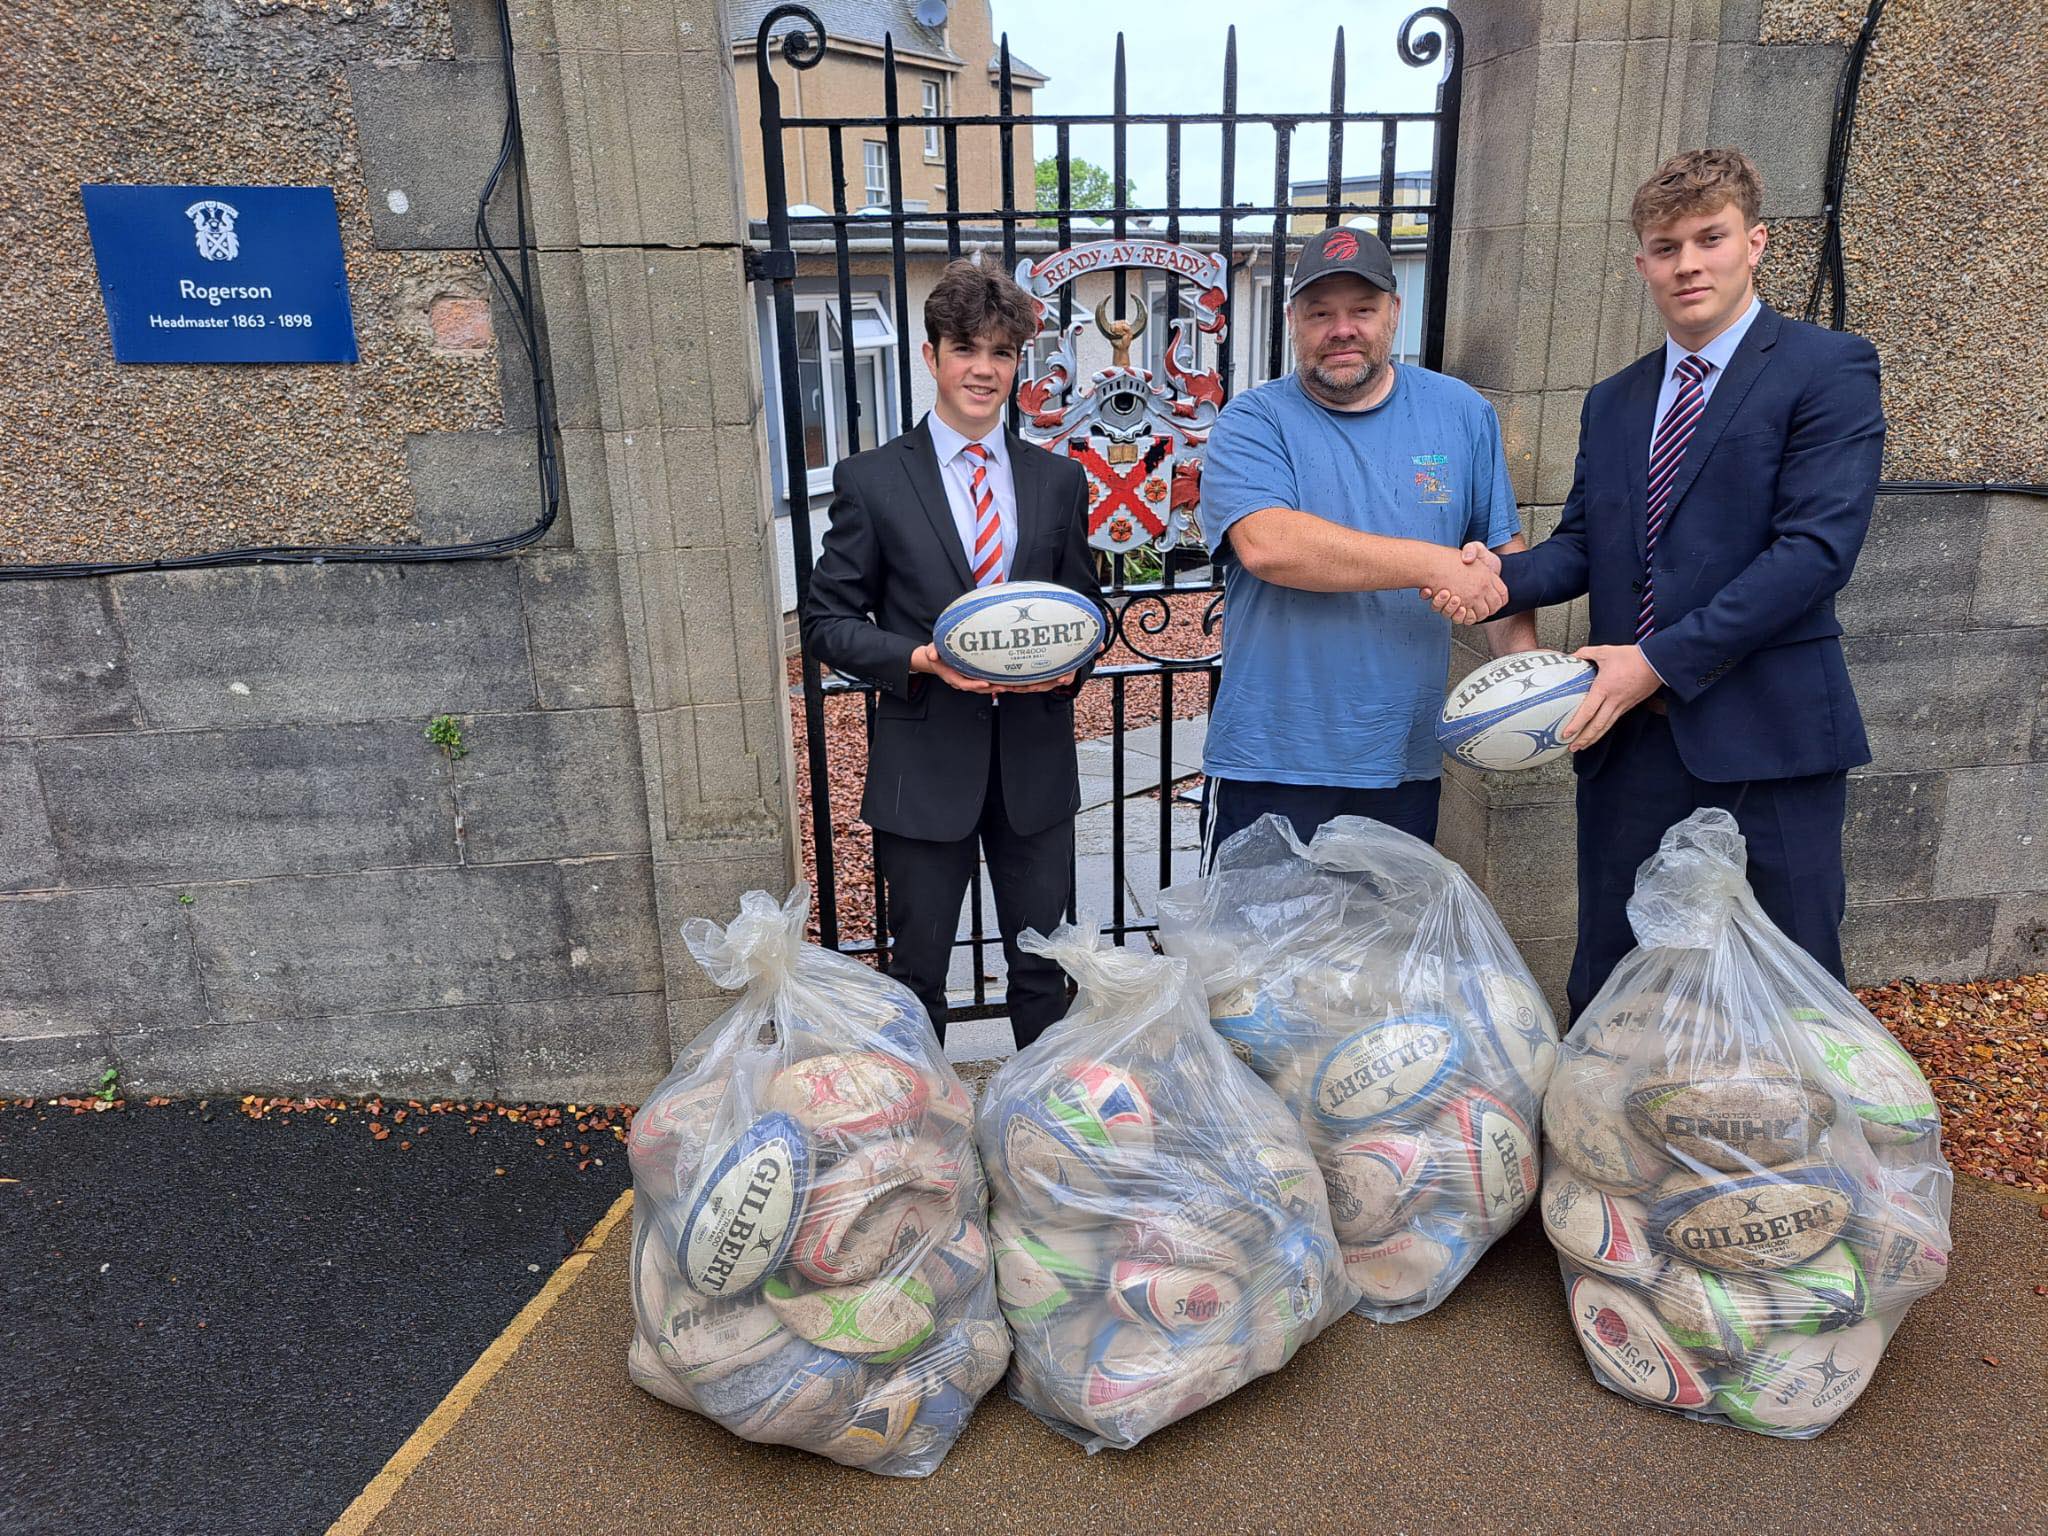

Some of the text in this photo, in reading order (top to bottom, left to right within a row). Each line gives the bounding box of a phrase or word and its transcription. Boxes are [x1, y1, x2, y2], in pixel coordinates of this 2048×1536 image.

[1043, 246, 1207, 288] READY AY READY
[179, 280, 272, 306] Rogerson
[149, 314, 229, 328] Headmaster
[232, 314, 265, 328] 1863
[278, 314, 313, 328] 1898
[958, 620, 1086, 653] GILBERT
[1327, 1033, 1440, 1109] GILBERT
[702, 1157, 781, 1292] GILBERT
[1681, 1200, 1834, 1250] GILBERT
[1811, 1367, 1862, 1408] GILBERT
